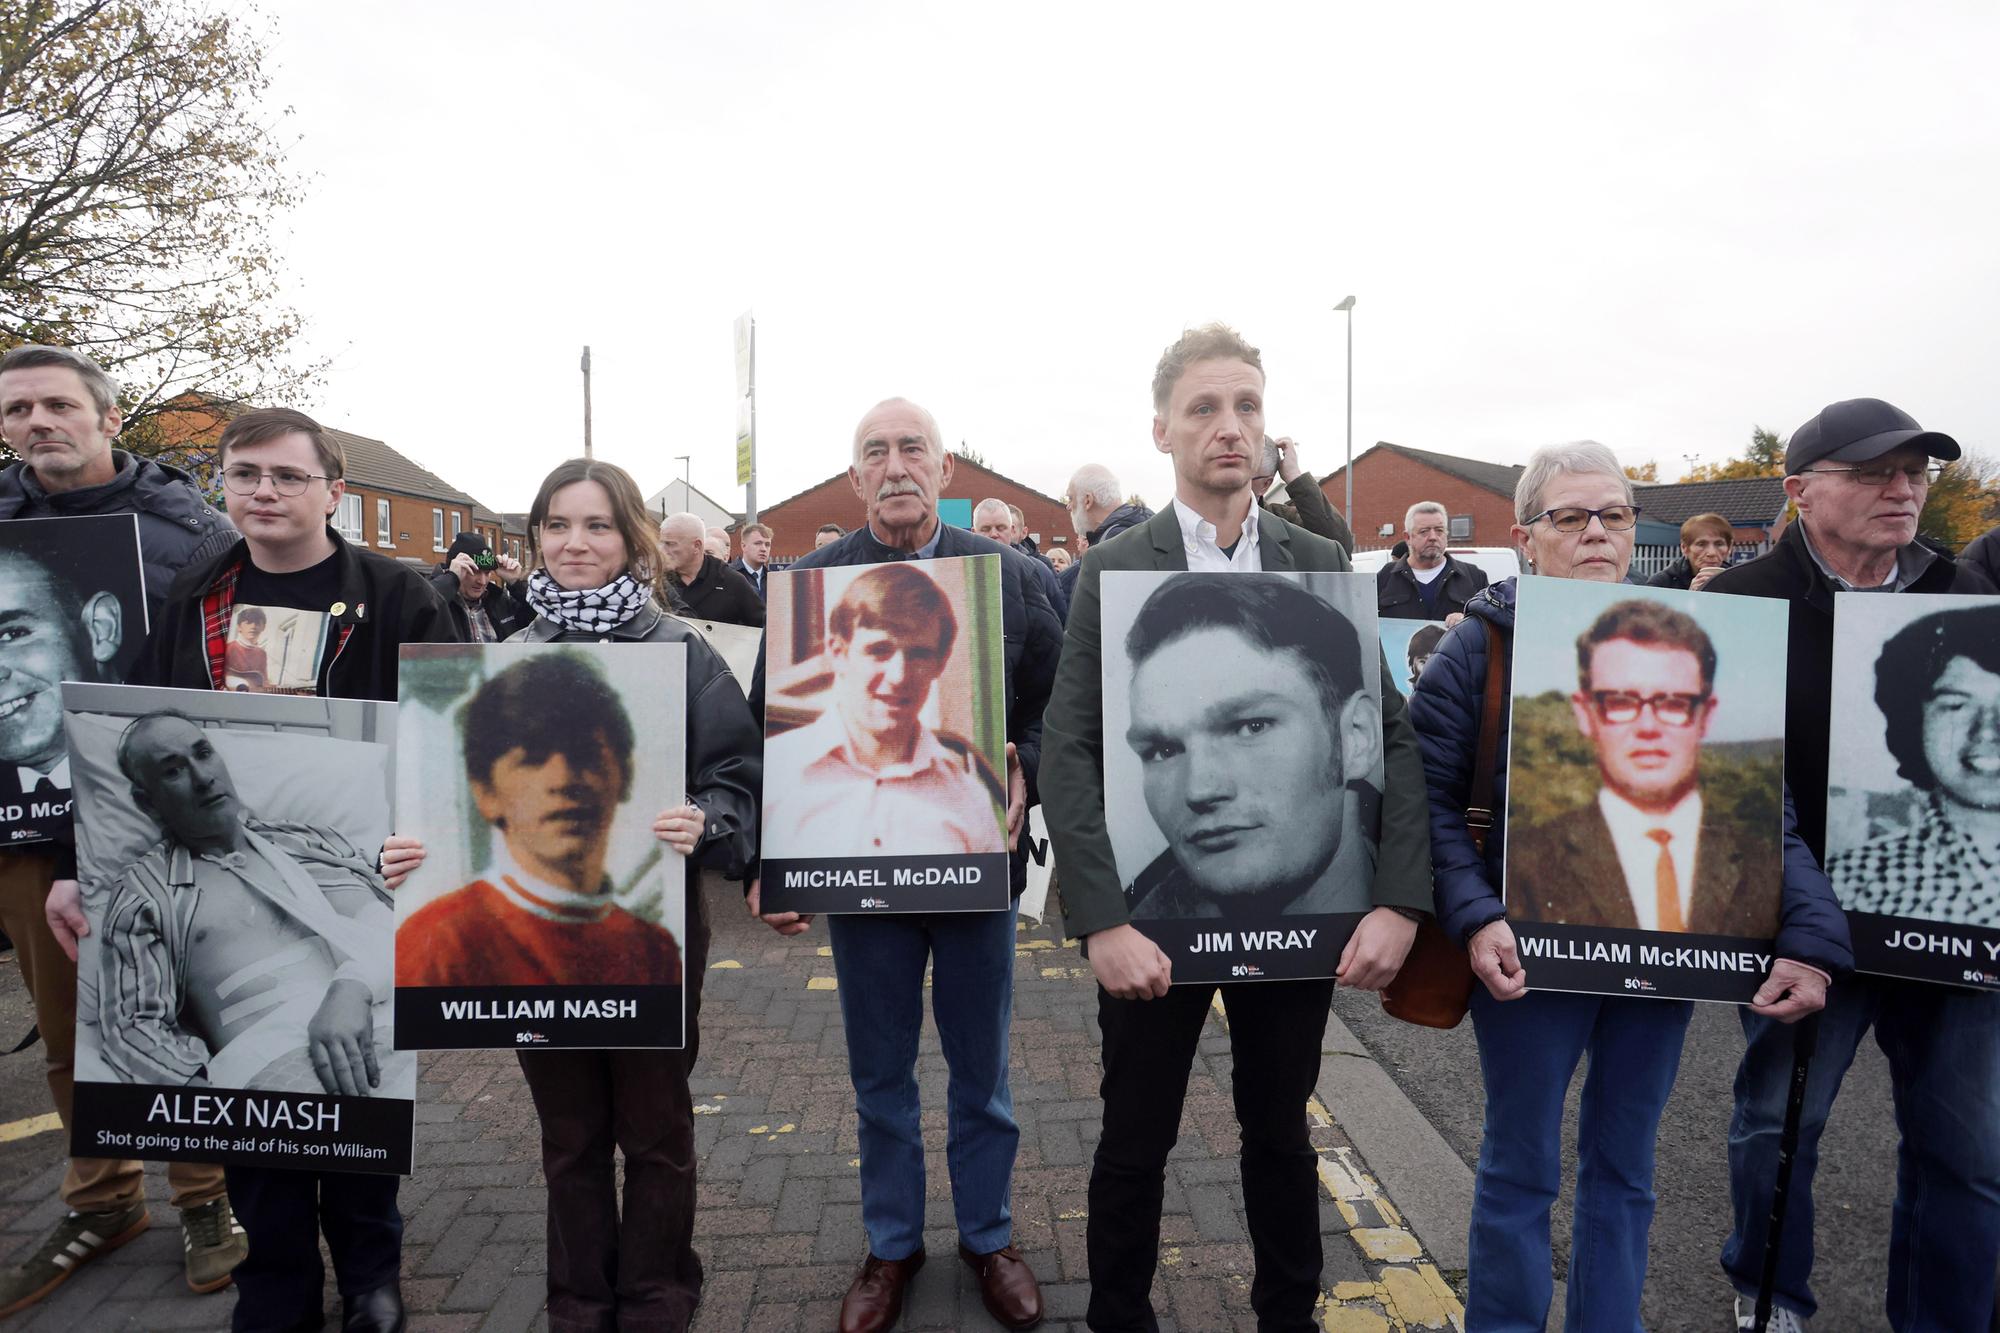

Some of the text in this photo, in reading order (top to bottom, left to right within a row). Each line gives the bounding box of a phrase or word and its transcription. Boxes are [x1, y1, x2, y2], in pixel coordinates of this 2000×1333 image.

[785, 866, 982, 888] MICHAEL McDAID
[1189, 930, 1318, 953] JIM WRAY
[1519, 936, 1771, 974] WILLIAM McKINNEY
[1884, 930, 1972, 958] JOHN
[440, 999, 637, 1020] WILLIAM NASH
[147, 1093, 341, 1132] ALEX NASH
[96, 1130, 388, 1160] Shot going to the aid of his son William
